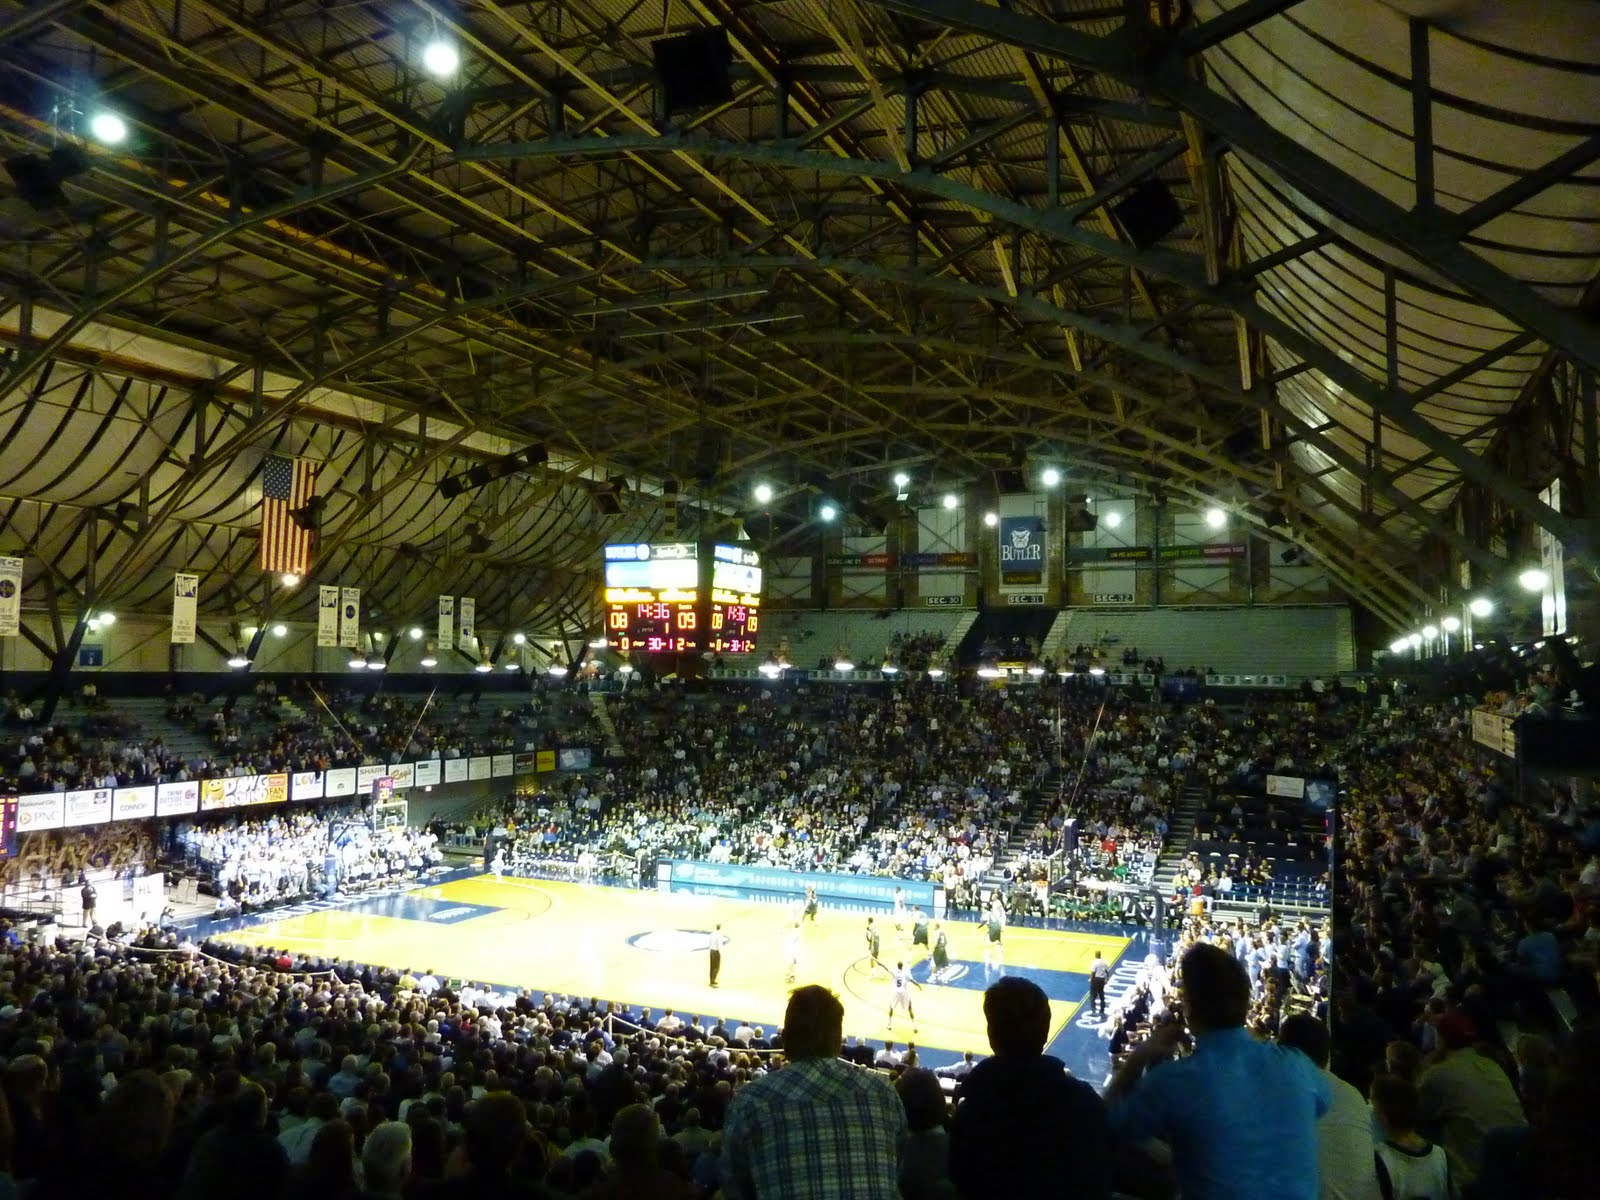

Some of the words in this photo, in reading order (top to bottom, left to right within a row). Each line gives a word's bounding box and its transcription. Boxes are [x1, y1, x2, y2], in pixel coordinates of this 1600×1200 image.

[1001, 544, 1041, 562] BUTLER
[949, 596, 960, 605] 30
[637, 603, 670, 619] 14:36
[728, 606, 746, 622] 14:36
[610, 612, 628, 629] 08
[677, 612, 696, 629] 09
[711, 613, 723, 630] 08
[664, 622, 669, 634] 1
[621, 637, 629, 650] 0
[677, 638, 685, 651] 2
[359, 767, 386, 776] SHARP
[270, 787, 284, 795] FAN
[34, 810, 59, 822] PNC
